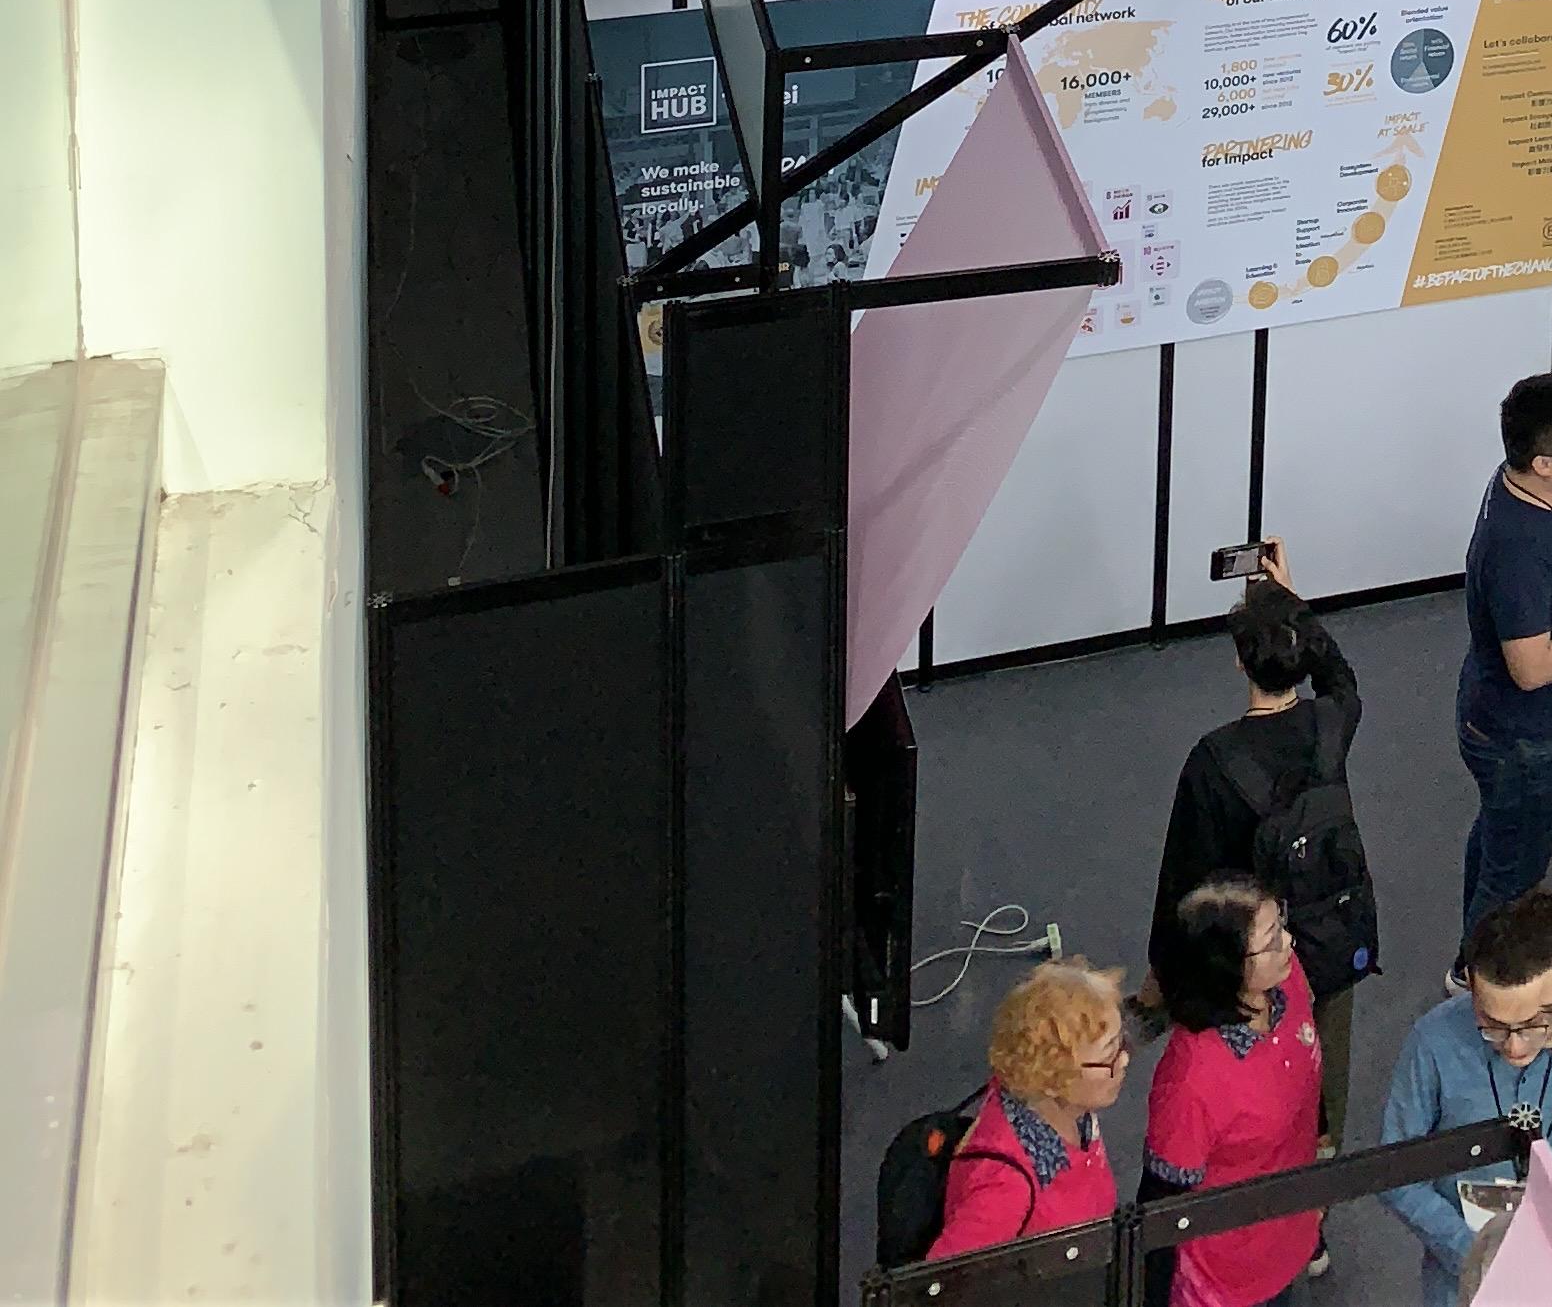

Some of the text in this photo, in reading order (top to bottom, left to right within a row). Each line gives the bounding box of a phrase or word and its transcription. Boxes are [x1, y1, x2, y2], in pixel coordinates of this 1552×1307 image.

[1076, 6, 1137, 24] network
[1326, 11, 1379, 44] 60%
[1483, 37, 1507, 50] Let's
[1220, 59, 1258, 74] 1,800
[1059, 70, 1132, 91] 16,000+
[1203, 74, 1257, 90] 10,000+
[650, 83, 707, 100] IMPACT
[1083, 89, 1122, 101] MEMBERS
[1217, 87, 1257, 103] 6,000
[650, 96, 708, 121] HUB
[1201, 103, 1256, 119] 29,000+
[1202, 129, 1314, 156] PARTNERING
[1201, 148, 1274, 168] for Impact
[640, 160, 720, 180] We make
[640, 173, 741, 198] sustainable
[640, 197, 704, 217] locally.
